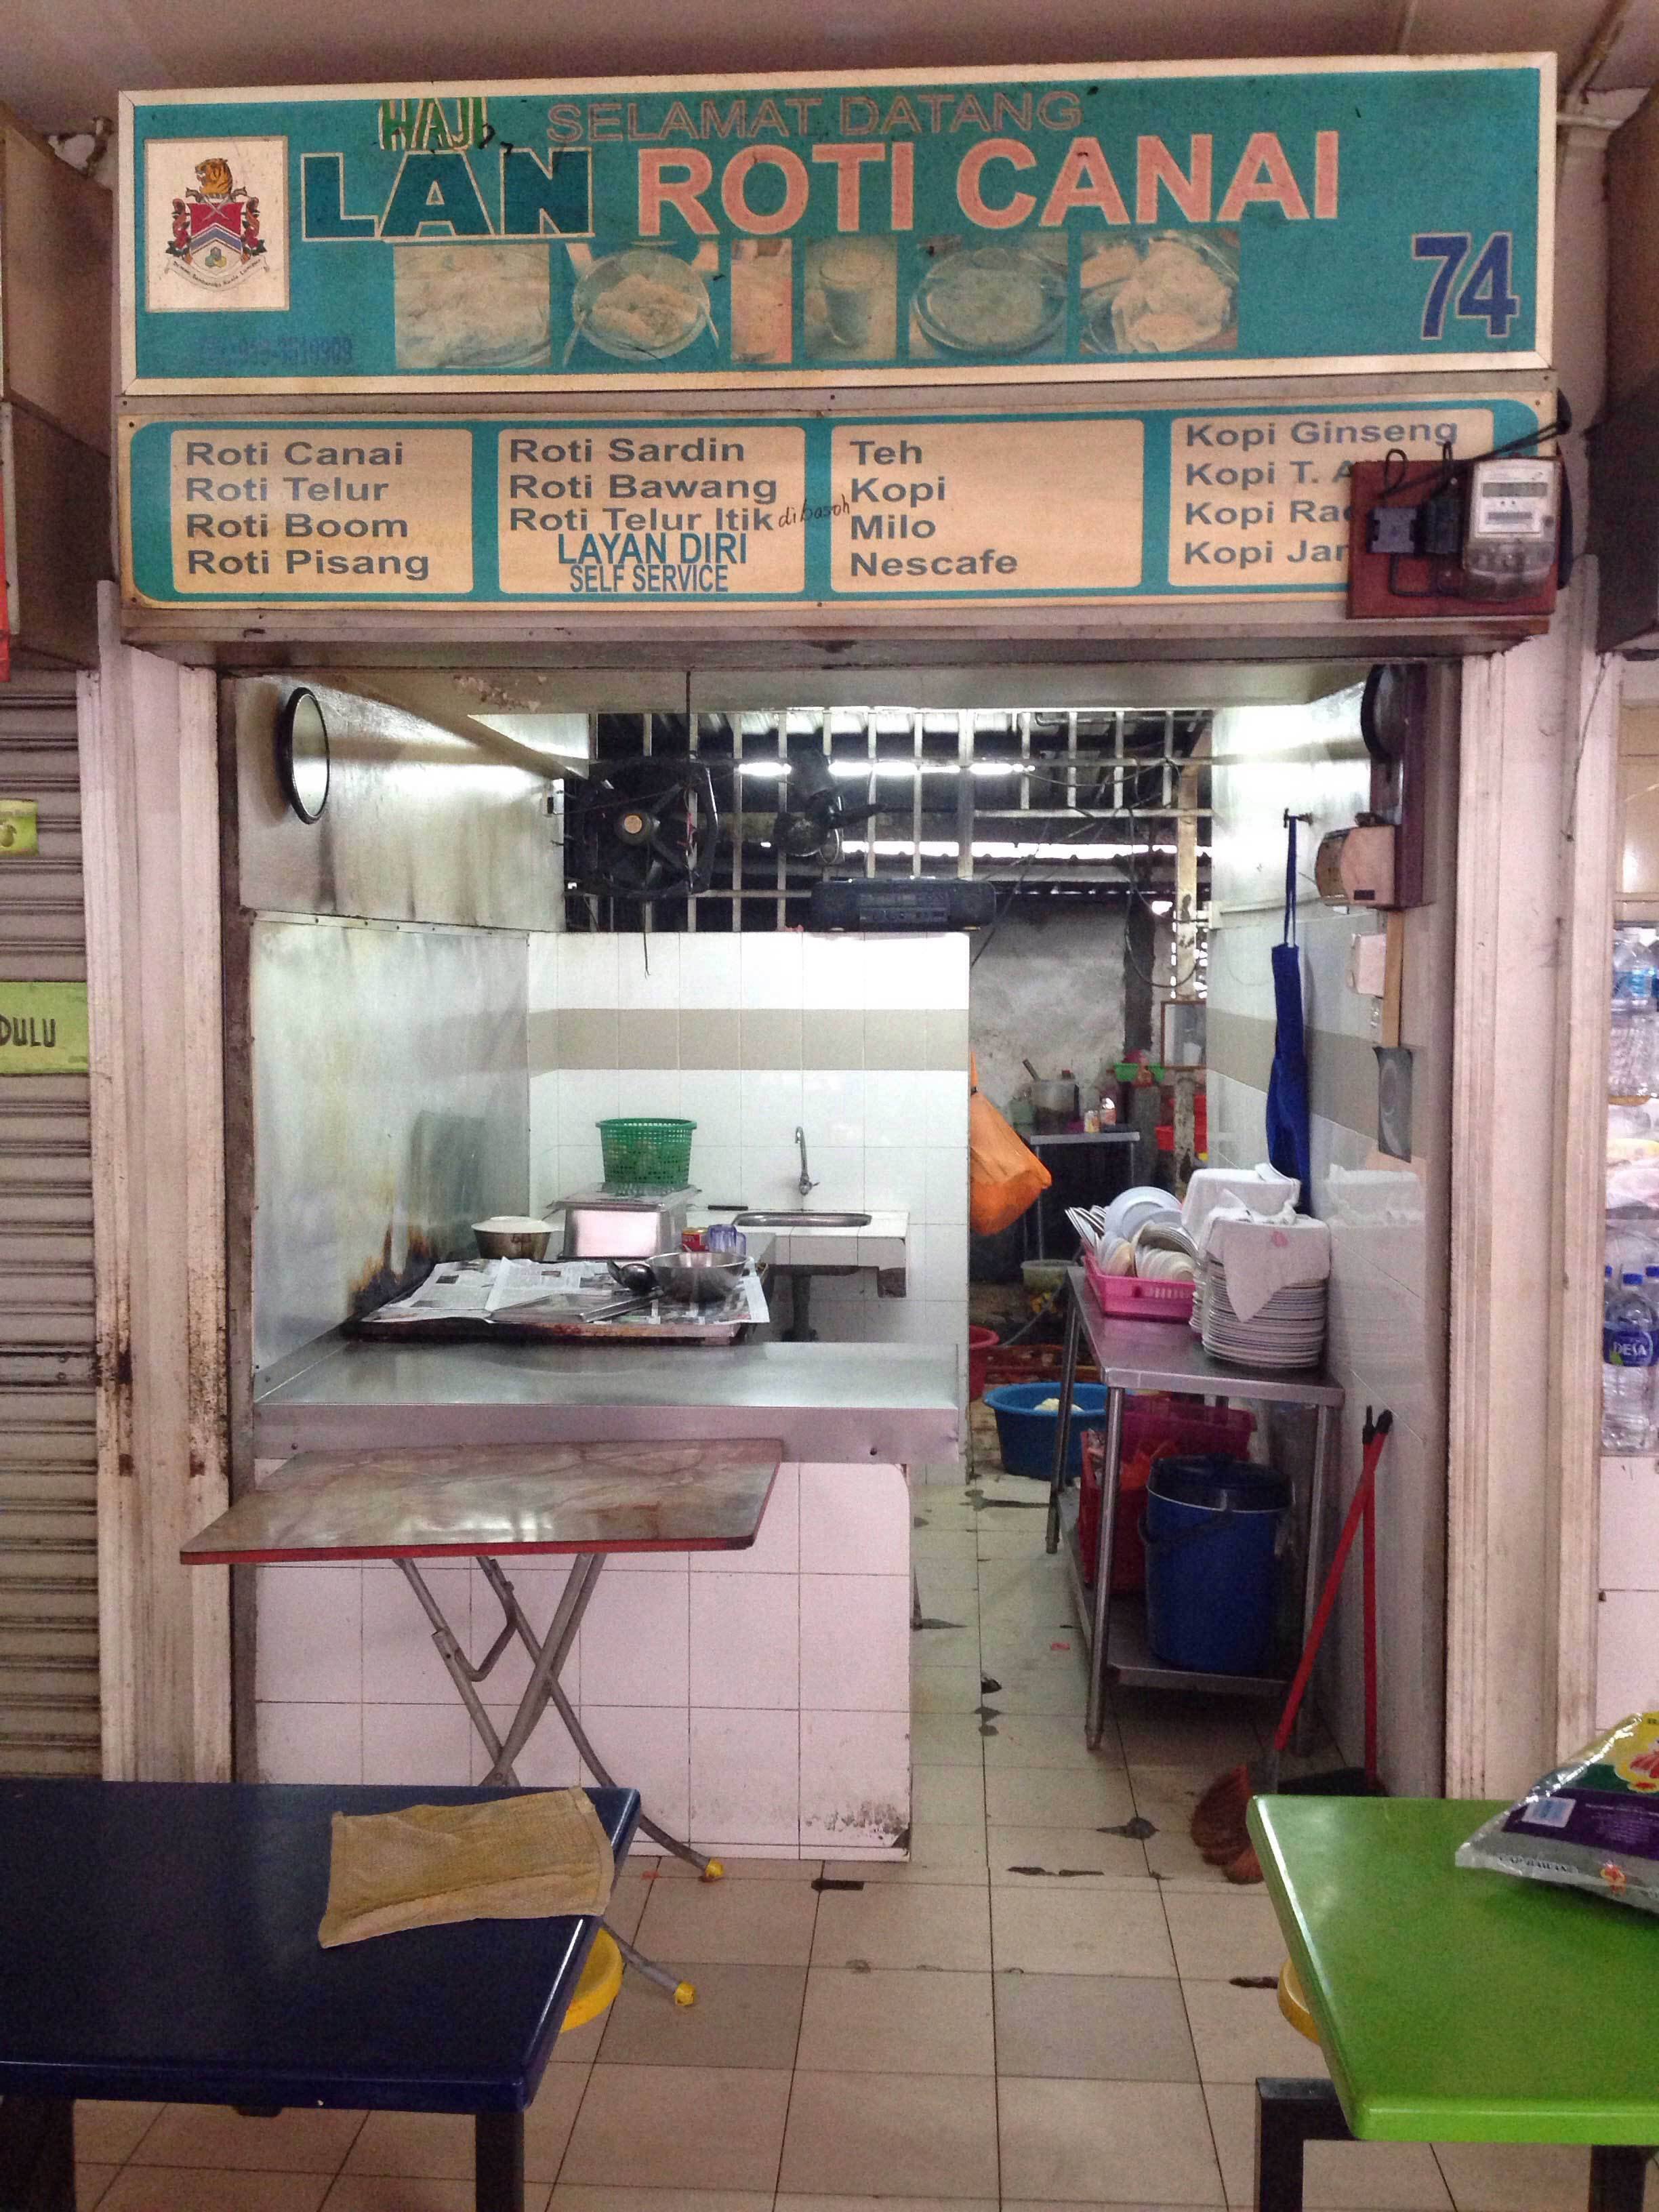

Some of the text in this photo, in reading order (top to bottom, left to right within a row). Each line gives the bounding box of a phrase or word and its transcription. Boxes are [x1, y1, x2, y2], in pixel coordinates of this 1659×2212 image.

[546, 89, 1084, 142] SELAMAT DATANG
[300, 130, 1340, 241] LAN ROTI CANAI
[1412, 231, 1521, 341] 74
[1187, 419, 1458, 451] Kopi Ginseng
[186, 441, 403, 466] Roti Canai
[510, 438, 744, 463] Roti Sardin
[850, 440, 923, 466] Teh
[186, 476, 389, 501] Roti Telur
[510, 474, 777, 504] Roti Bawang
[1186, 462, 1275, 490] Kopi
[1290, 460, 1319, 484] T.
[852, 476, 946, 506] Kopi
[186, 513, 408, 537] Roti Boom
[510, 507, 775, 531] Roti Telur Itik
[852, 514, 936, 540] Milo
[1185, 501, 1274, 529] Kopi
[558, 532, 746, 564] LAYAN DIRI
[1185, 541, 1273, 569] Kopi
[188, 549, 430, 581] Roti Pisang
[852, 549, 1018, 576] Nescafe
[570, 565, 729, 592] SELF SERVICE
